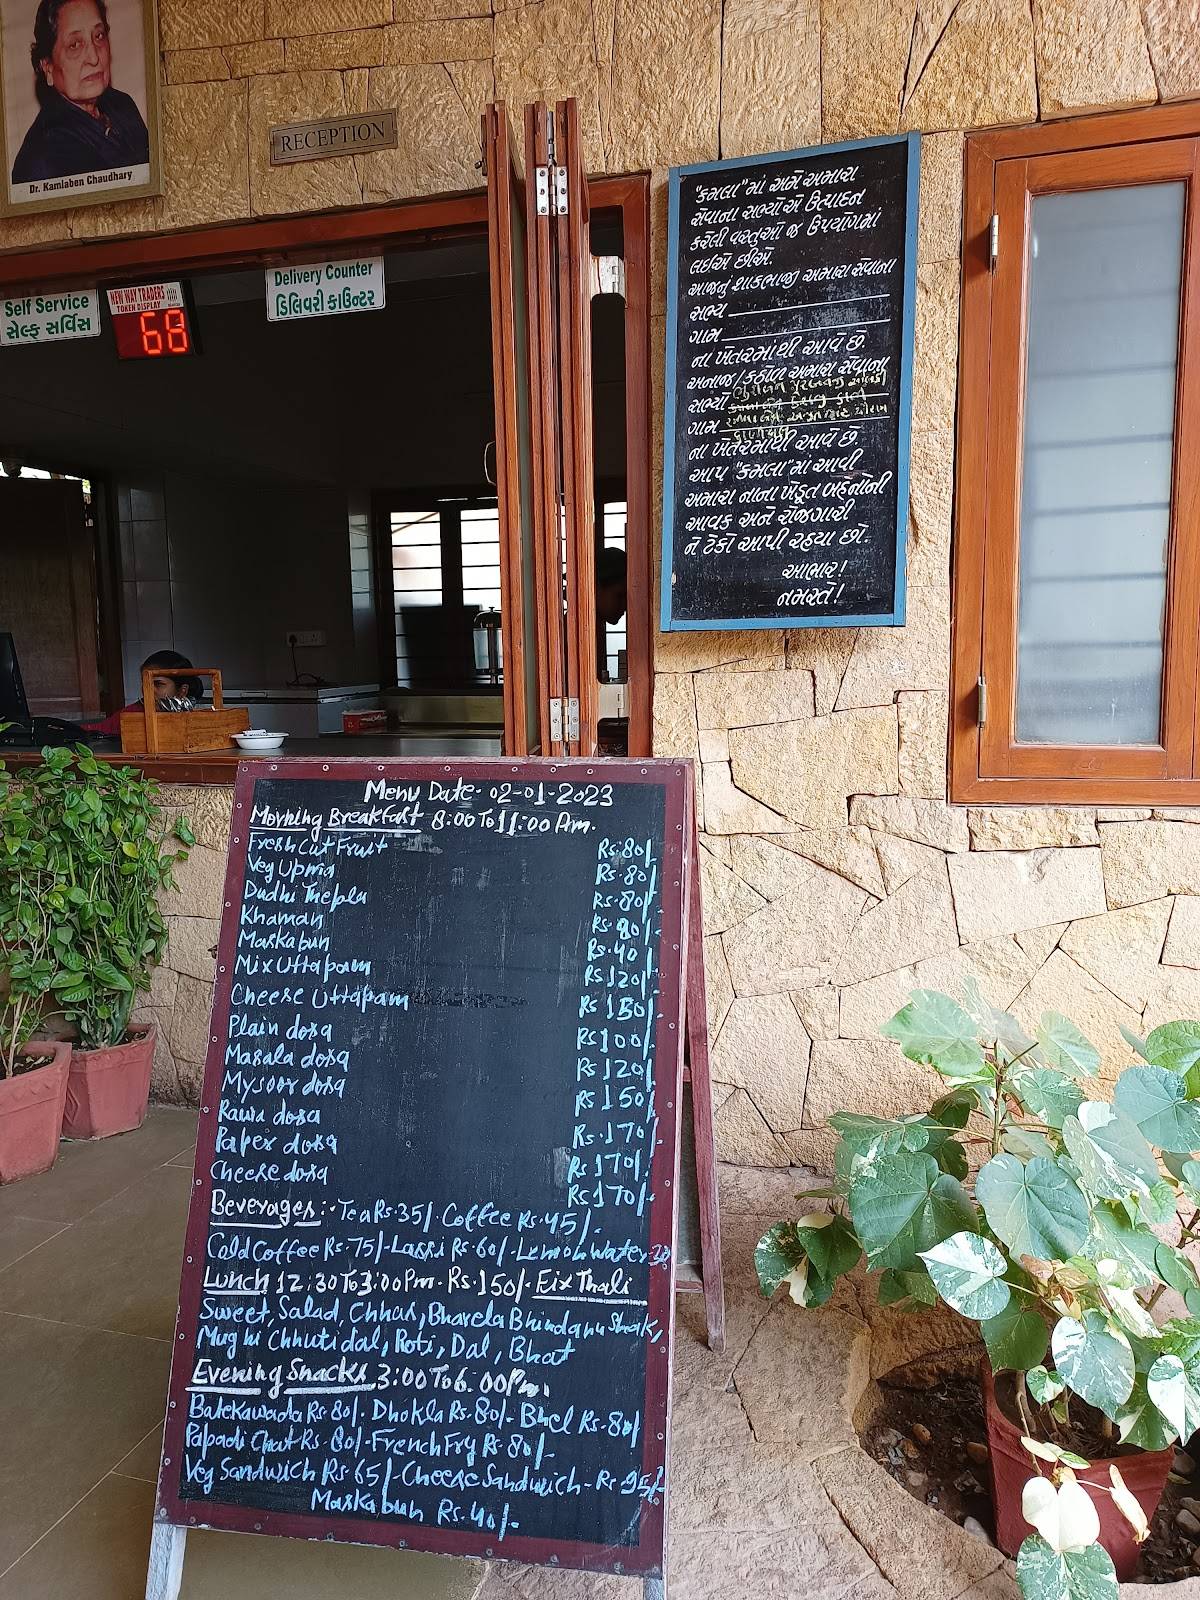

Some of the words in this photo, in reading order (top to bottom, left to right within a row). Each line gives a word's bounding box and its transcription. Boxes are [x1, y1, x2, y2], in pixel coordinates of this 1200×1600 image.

[281, 122, 385, 153] RECEPTION
[29, 184, 41, 195] Dr.
[43, 178, 85, 193] Kamlaben
[86, 169, 134, 186] Chaudhary
[769, 170, 801, 192] અમે
[803, 166, 859, 187] અમારા
[690, 208, 740, 226] સેવાના
[804, 189, 866, 213] ઉત્પાદન
[689, 227, 729, 252] કરેલી
[729, 221, 786, 247] વસ્તુઓ
[786, 223, 802, 237] જ
[807, 206, 882, 237] ઉપયોગમાં
[274, 268, 322, 286] Delivery
[325, 261, 373, 280] Counter
[688, 274, 731, 299] આજનું
[731, 270, 800, 293] શાકભાજી
[801, 262, 851, 282] અમારા
[851, 257, 896, 277] સેવાના
[5, 299, 31, 317] Self
[35, 293, 89, 313] Service
[110, 289, 124, 305] NEW
[124, 288, 137, 303] WAY
[138, 285, 165, 301] TRADERS
[117, 303, 136, 313] TOKEN
[137, 300, 161, 310] DISPLAY
[276, 288, 324, 317] ડિલિવરી
[327, 287, 375, 310] કાઉન્ટર
[6, 320, 40, 339] સેલ્ફ
[46, 313, 91, 335] સર્વિસ
[690, 302, 729, 322] સભ્ય
[140, 309, 189, 354] 68
[689, 326, 721, 345] ગામ
[691, 352, 711, 369] ના
[715, 336, 802, 367] ખેતરમાંથી
[802, 332, 847, 355] આવે
[787, 361, 838, 380] અમારા
[838, 356, 890, 377] સેવાના
[687, 391, 731, 414] સભ્યો
[688, 418, 720, 436] ગામ
[688, 444, 710, 461] ના
[795, 427, 840, 450] આવે
[689, 464, 729, 484] આપ
[812, 447, 864, 473] આવી
[684, 489, 737, 508] અમારા
[738, 486, 780, 503] નાના
[780, 481, 818, 505] ખેડૂત
[822, 470, 893, 501] બહેનોની
[685, 513, 733, 531] આવક
[738, 505, 776, 527] અને
[778, 499, 856, 525] રોજગારી
[684, 536, 700, 556] ને
[703, 532, 738, 554] ટેકો
[738, 527, 790, 552] આપી
[363, 778, 421, 802] Menu
[249, 805, 323, 842] Morning
[248, 831, 296, 853] Fresh
[298, 835, 335, 857] Cut
[336, 831, 388, 858] Fruit
[248, 854, 275, 883] Veg
[279, 857, 335, 884] Upma
[244, 880, 296, 904] Dudhi
[302, 881, 368, 912] Thepla
[240, 904, 324, 929] Khaman
[235, 953, 273, 975] Mix
[230, 982, 304, 1007] Cheese
[228, 1014, 278, 1039] Plain
[224, 1042, 294, 1067] Masala
[215, 1126, 278, 1157] Paper
[210, 1159, 281, 1184] Cheese
[338, 1198, 371, 1223] Tea
[442, 1201, 512, 1233] Coffee
[207, 1232, 250, 1261] Cold
[252, 1238, 320, 1265] Coffee
[203, 1266, 270, 1291] Lunch
[276, 1271, 337, 1293] 12:30
[575, 1267, 633, 1296] Thali
[195, 1324, 238, 1360] Mug
[508, 1334, 576, 1366] Bhat
[192, 1358, 283, 1400] Evening
[286, 1355, 368, 1385] Snacks
[520, 1401, 574, 1434] Bhel
[185, 1421, 247, 1461] Papadi
[371, 1428, 441, 1457] French
[444, 1431, 477, 1467] Fry
[185, 1454, 214, 1495] Veg
[219, 1455, 315, 1484] Sandwich
[401, 1460, 480, 1491] Cheese
